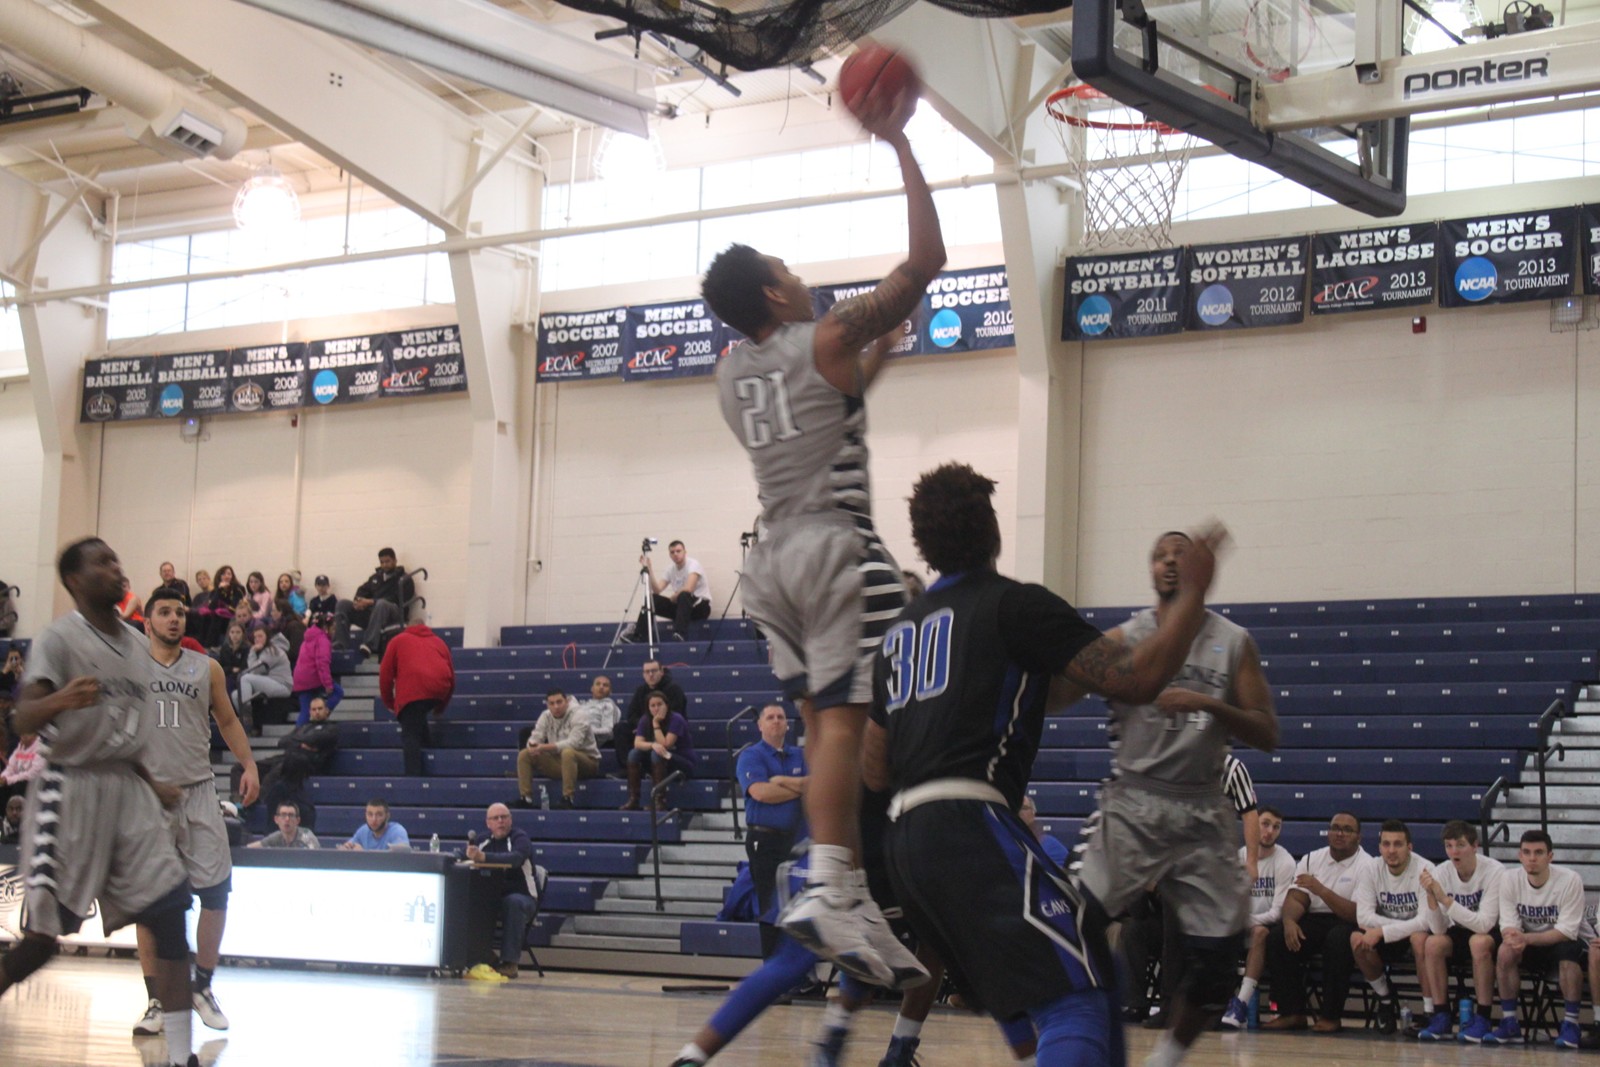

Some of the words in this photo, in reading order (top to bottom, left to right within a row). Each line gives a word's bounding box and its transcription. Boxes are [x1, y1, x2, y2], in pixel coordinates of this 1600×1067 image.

[1466, 215, 1550, 238] MEN'S
[1339, 228, 1410, 249] MEN'S
[1454, 232, 1563, 258] SOCCER
[1196, 243, 1300, 266] WOMEN'S
[1316, 242, 1434, 269] LACROSSE
[1076, 255, 1175, 277] WOMEN'S
[1190, 262, 1306, 284] SOFTBALL
[1518, 258, 1556, 276] 2013
[1071, 274, 1180, 295] SOFTBALL
[1390, 271, 1426, 288] 2013
[1458, 276, 1496, 292] NCAA
[1504, 274, 1569, 291] TOURNAMENT
[1260, 286, 1294, 303] 2012
[1324, 281, 1371, 302] ECAC
[1382, 287, 1432, 302] TOURNAMENT
[644, 304, 704, 322] MEN'S
[1137, 298, 1168, 312] 2011
[1201, 304, 1233, 316] NCAA
[1250, 302, 1303, 316] TOURNAMENT
[541, 309, 626, 330] WOMEN'S
[984, 310, 1014, 326] 2010
[1080, 314, 1111, 326] NCAA
[1127, 312, 1178, 325] TOURNAMENT
[547, 325, 620, 344] SOCCER
[636, 318, 713, 338] SOCCER
[932, 327, 961, 340] NCAA
[325, 337, 370, 354] MEN'S
[402, 328, 454, 346] MEN'S
[246, 346, 288, 362] MEN'S
[393, 342, 460, 360] SOCCER
[592, 343, 618, 358] 2007
[684, 340, 712, 356] 2008
[172, 354, 214, 368] MEN'S
[309, 350, 384, 370] BASEBALL
[545, 355, 582, 372] ECAC
[635, 348, 672, 367] ECAC
[678, 354, 717, 366] TOURNAMENT
[100, 360, 140, 374] MEN'S
[158, 366, 228, 383] BASEBALL
[232, 359, 304, 378] BASEBALL
[435, 362, 459, 376] 2006
[86, 372, 152, 388] BASEBALL
[274, 376, 298, 390] 2006
[356, 370, 378, 385] 2006
[390, 370, 423, 387] ECAC
[126, 388, 146, 401] 2005
[199, 386, 221, 399] 2005
[733, 369, 803, 450] 21
[883, 607, 954, 715] 30
[157, 700, 180, 728] 11
[1040, 898, 1071, 917] CAVS
